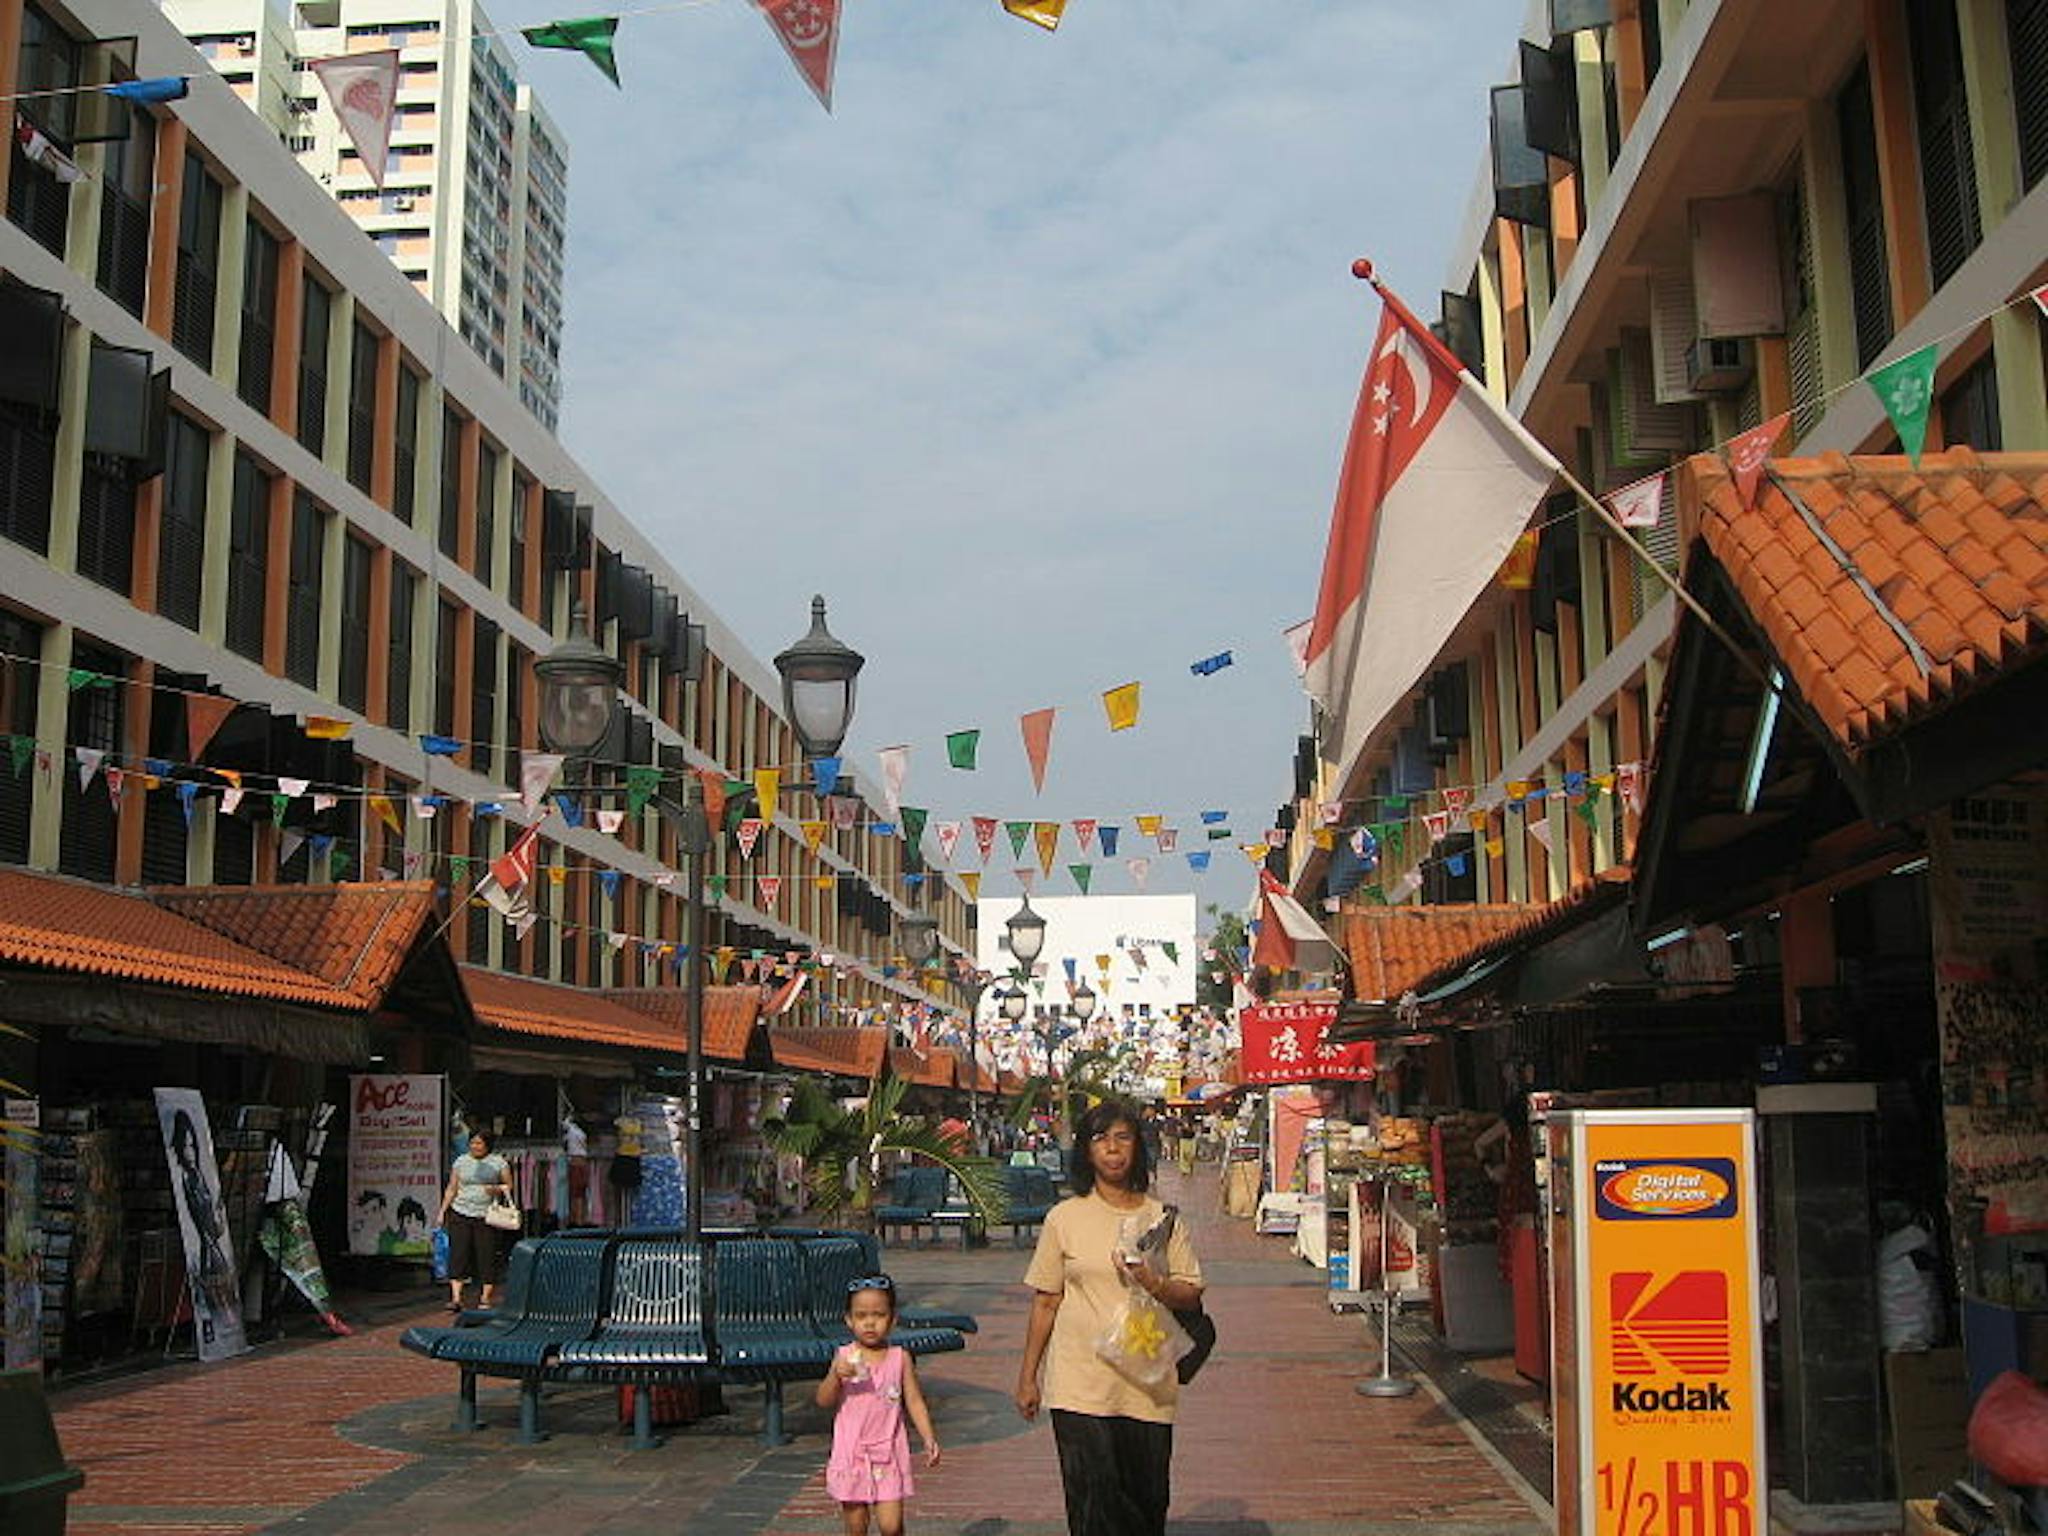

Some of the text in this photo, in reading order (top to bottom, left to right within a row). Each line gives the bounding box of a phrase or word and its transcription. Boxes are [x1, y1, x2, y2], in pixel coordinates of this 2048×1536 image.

[1637, 1173, 1702, 1188] Digital
[1631, 1187, 1707, 1201] Services
[1613, 1382, 1731, 1412] Kodak
